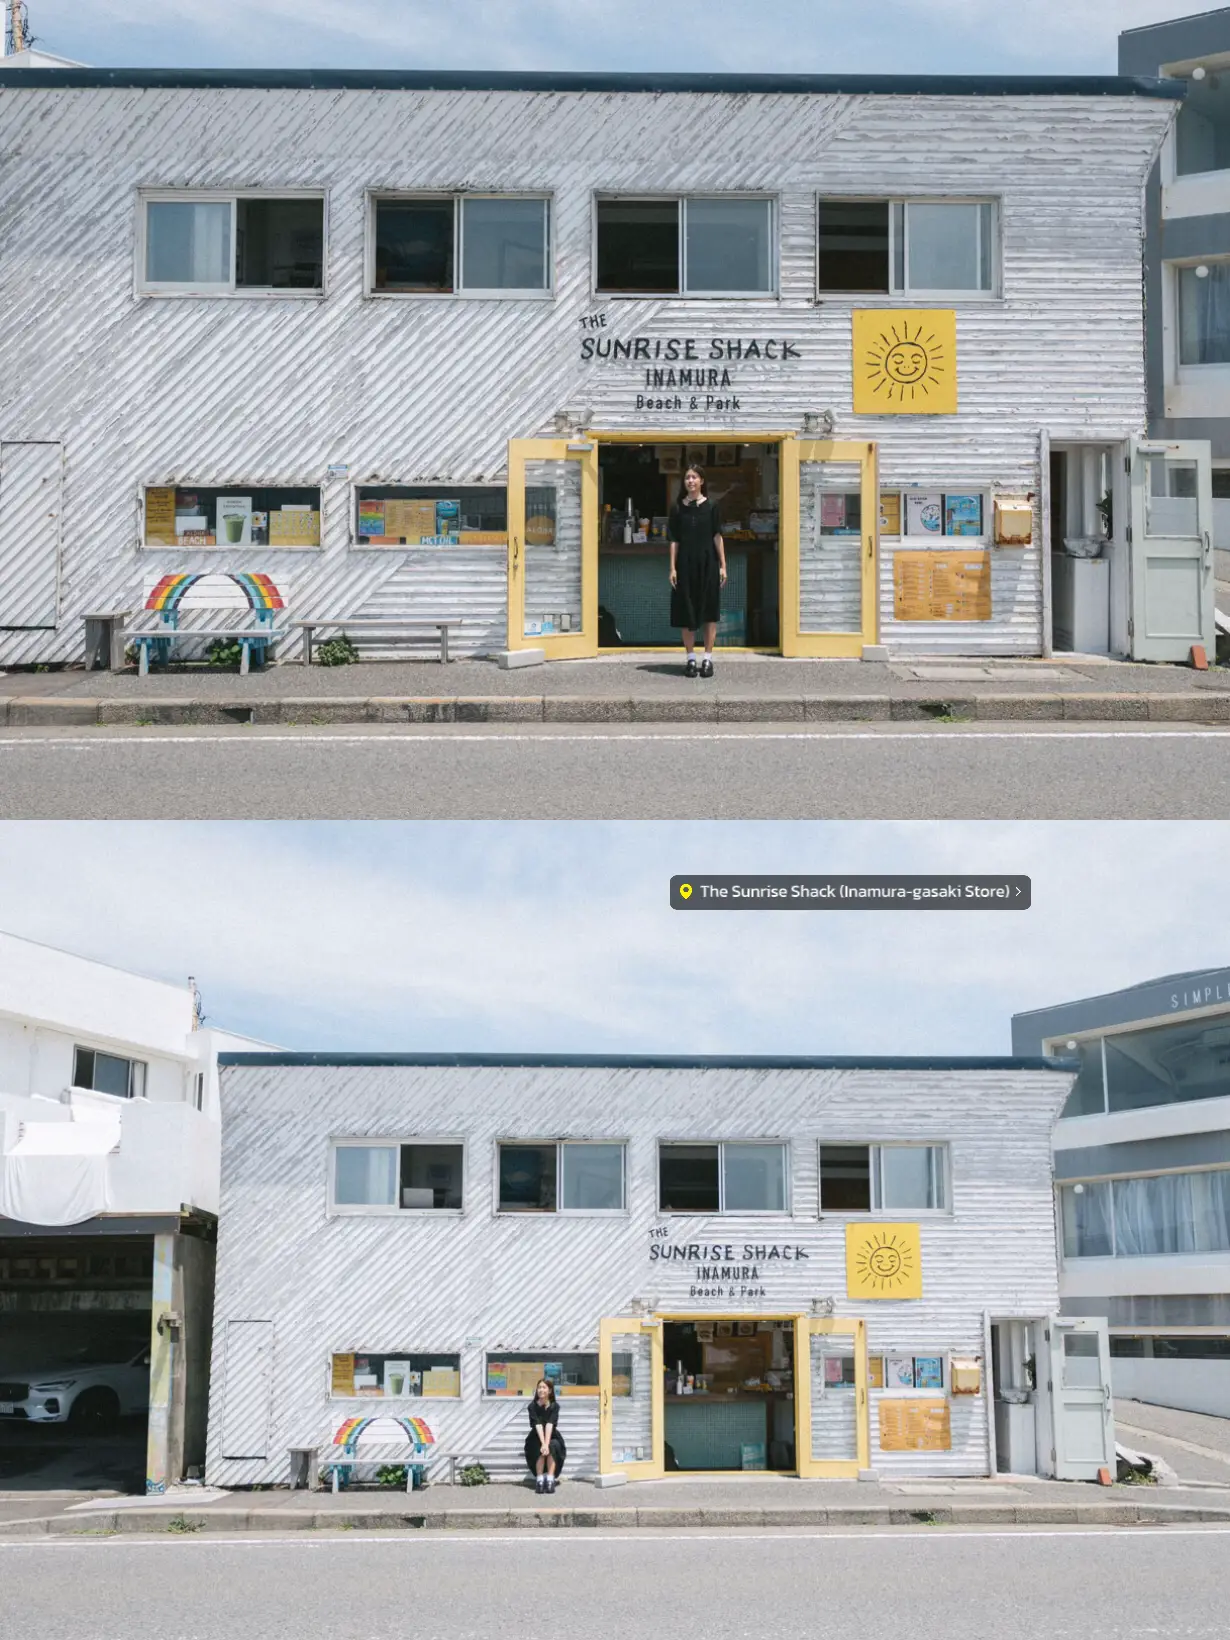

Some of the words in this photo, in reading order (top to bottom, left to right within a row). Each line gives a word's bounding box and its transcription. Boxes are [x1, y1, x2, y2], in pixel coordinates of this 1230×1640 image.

[578, 313, 608, 329] THE
[580, 336, 699, 361] SUNRISE
[708, 337, 802, 361] SHACK
[645, 368, 732, 387] INAMURA
[636, 394, 682, 410] Beach
[689, 395, 698, 410] &
[706, 394, 741, 410] Park
[178, 536, 206, 546] BEACH
[648, 1226, 669, 1238] THE
[649, 1244, 734, 1261] SUNRISE
[742, 1245, 810, 1261] SHACK
[696, 1266, 760, 1280] INAMURA
[690, 1285, 724, 1297] Beach
[728, 1286, 735, 1297] &
[740, 1285, 766, 1297] Park
